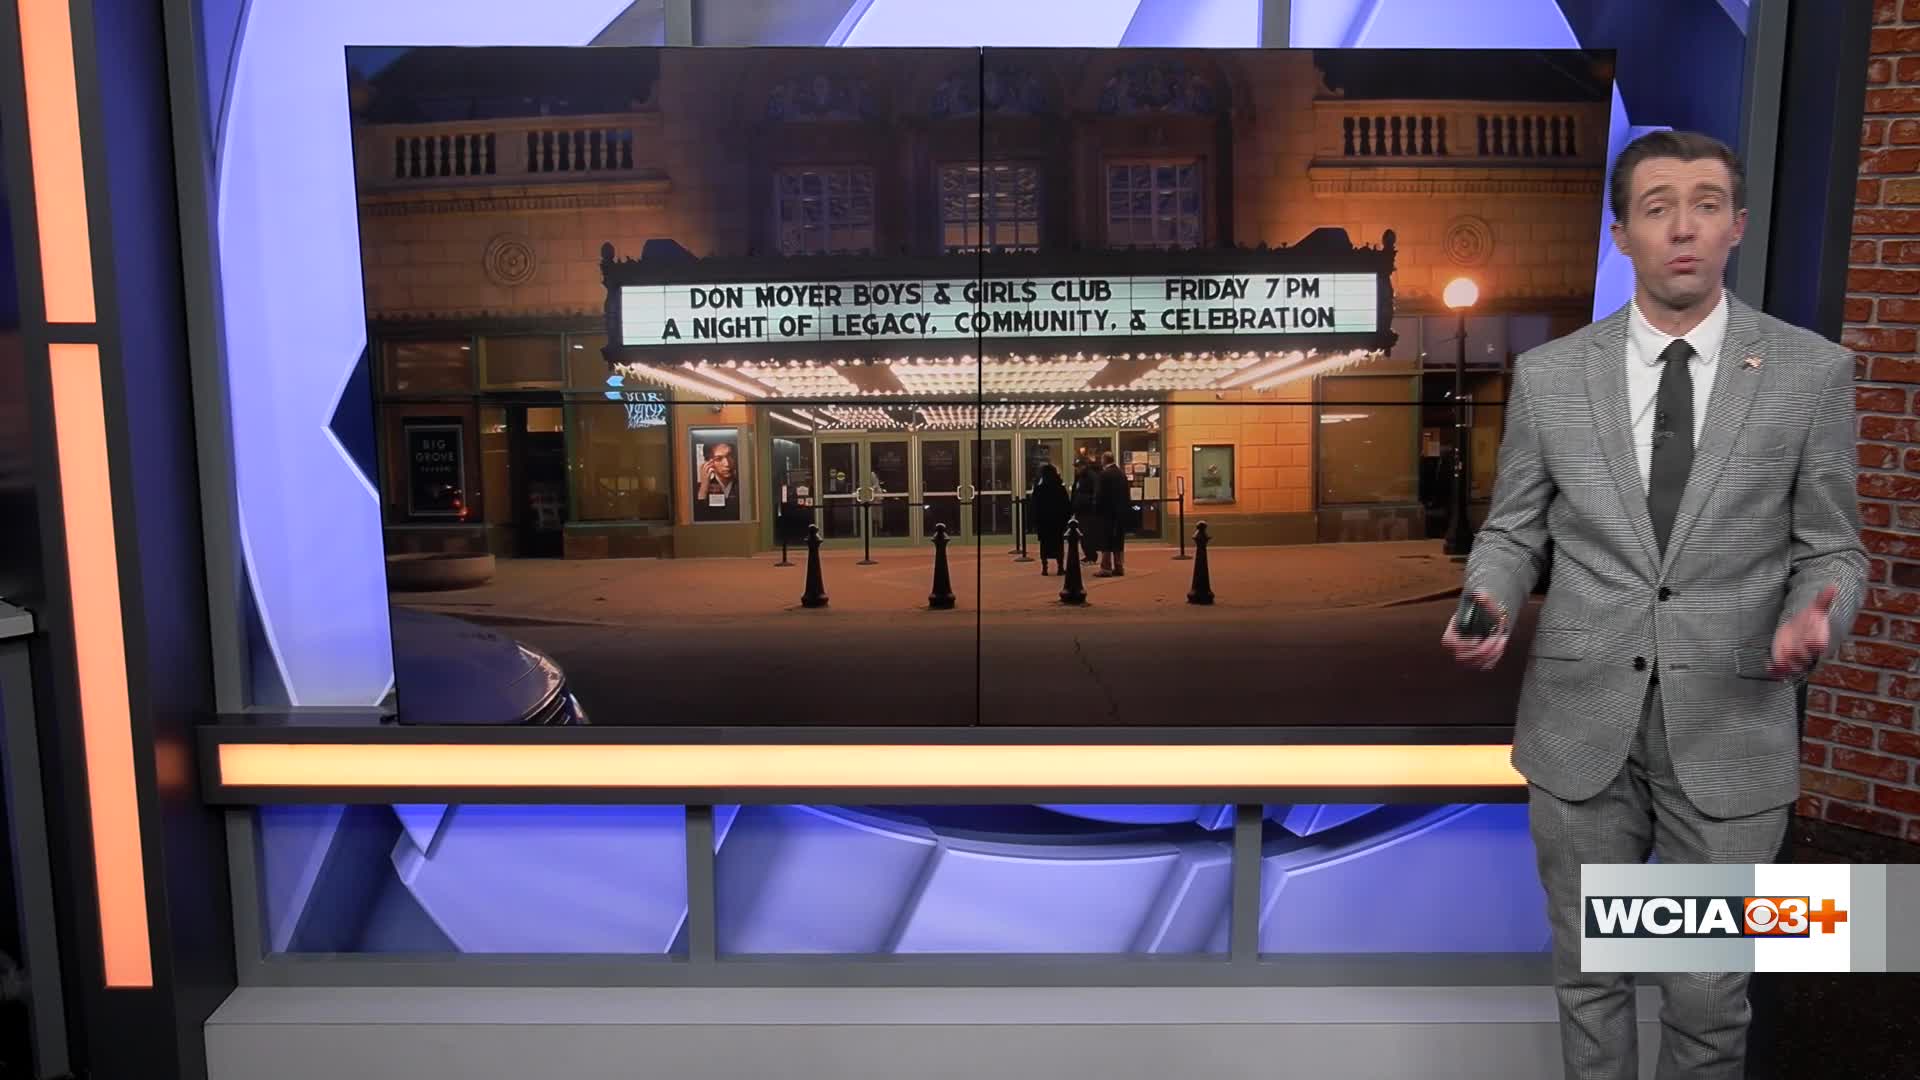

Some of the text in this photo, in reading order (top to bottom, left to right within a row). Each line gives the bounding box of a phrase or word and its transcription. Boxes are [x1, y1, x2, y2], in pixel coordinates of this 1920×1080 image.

[690, 277, 1320, 309] DON MOYER BOYS & GIRLS CLUB FRIDAY 7 PM
[661, 306, 1336, 340] A NIGHT OF LEGACY, COMMUNITY, & CELEBRATION
